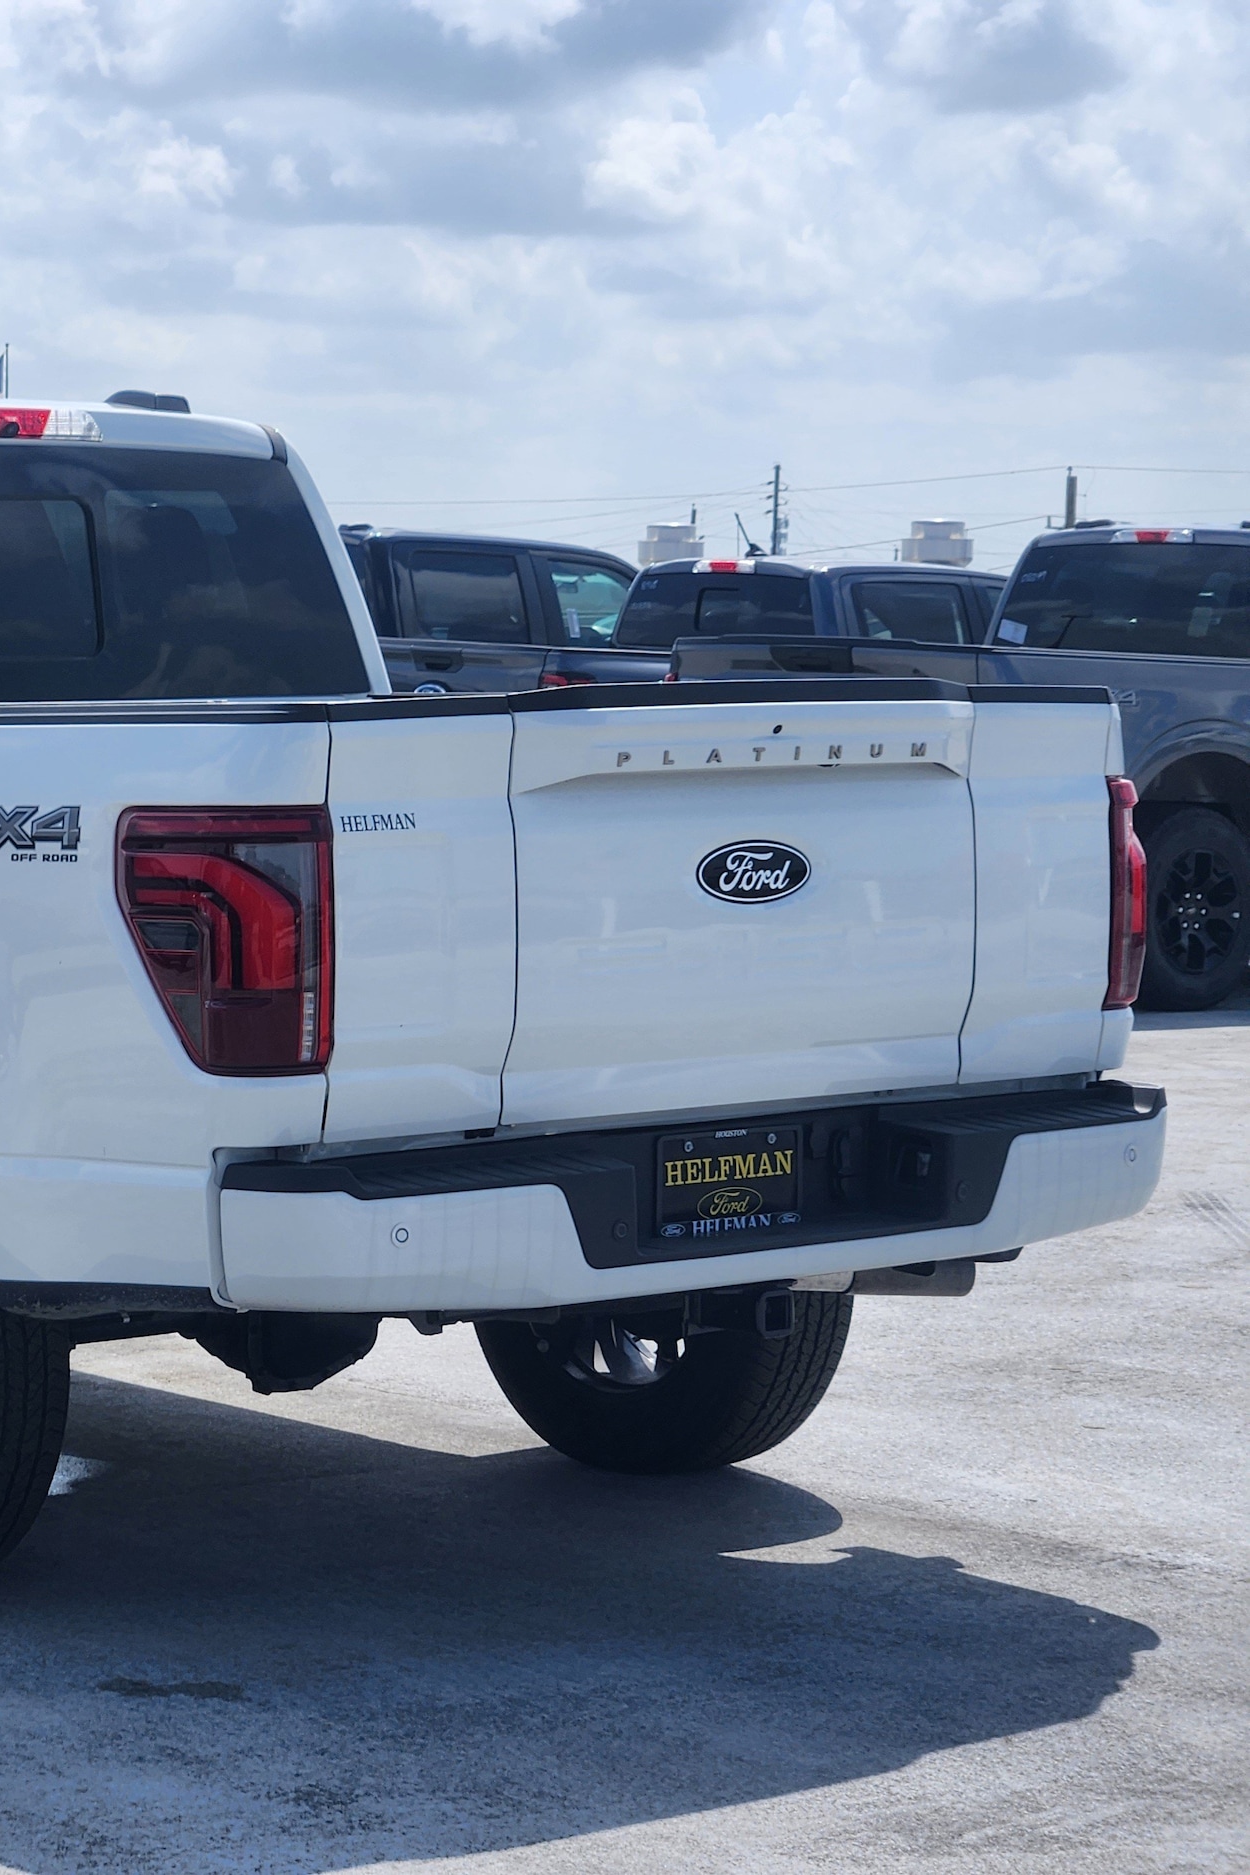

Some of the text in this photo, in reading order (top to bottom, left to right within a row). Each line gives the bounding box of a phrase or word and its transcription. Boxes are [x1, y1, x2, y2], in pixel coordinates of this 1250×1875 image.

[616, 742, 927, 767] PLATINUM
[340, 812, 416, 832] HELFMAN
[11, 853, 78, 862] OFF ROAD
[718, 851, 791, 892] Ford
[714, 1128, 748, 1139] HOUSTON
[664, 1149, 794, 1187] HELFMAN
[710, 1191, 750, 1215] Ford
